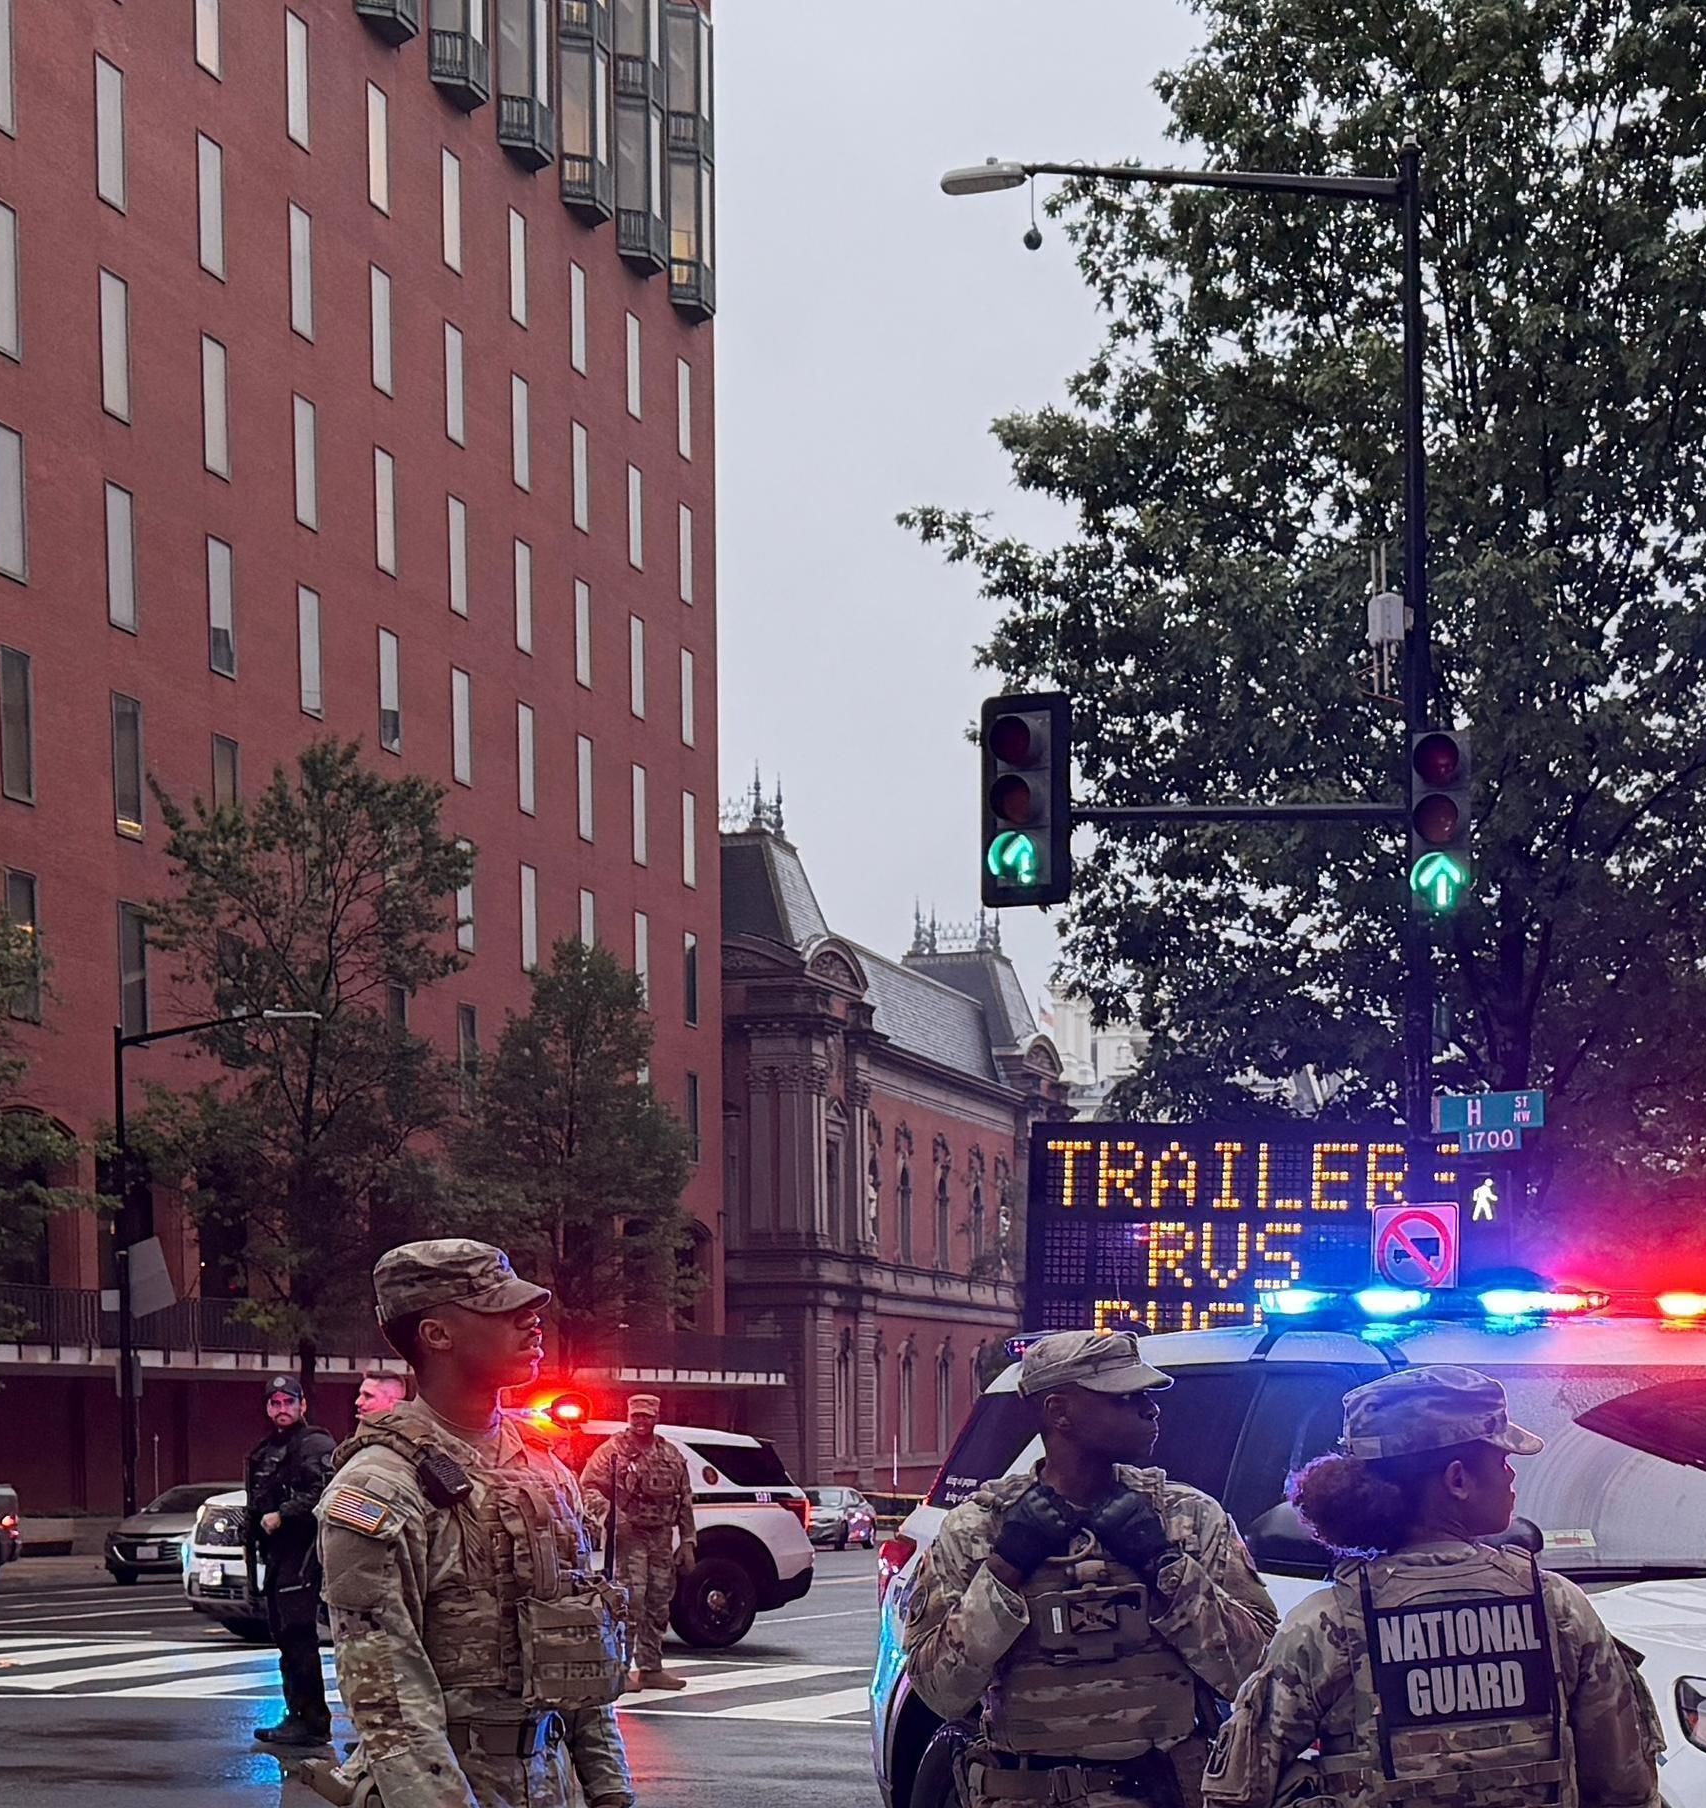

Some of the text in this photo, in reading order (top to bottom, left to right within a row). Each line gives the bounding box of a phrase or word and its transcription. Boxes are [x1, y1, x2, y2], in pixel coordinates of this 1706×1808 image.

[1466, 1095, 1529, 1126] H ST
[1513, 1110, 1531, 1123] NW
[1467, 1128, 1514, 1152] 1700
[1047, 1140, 1461, 1212] TRAILER
[1147, 1221, 1302, 1289] RVS
[1377, 1604, 1542, 1664] NATIONAL
[1406, 1660, 1526, 1717] GUARD
